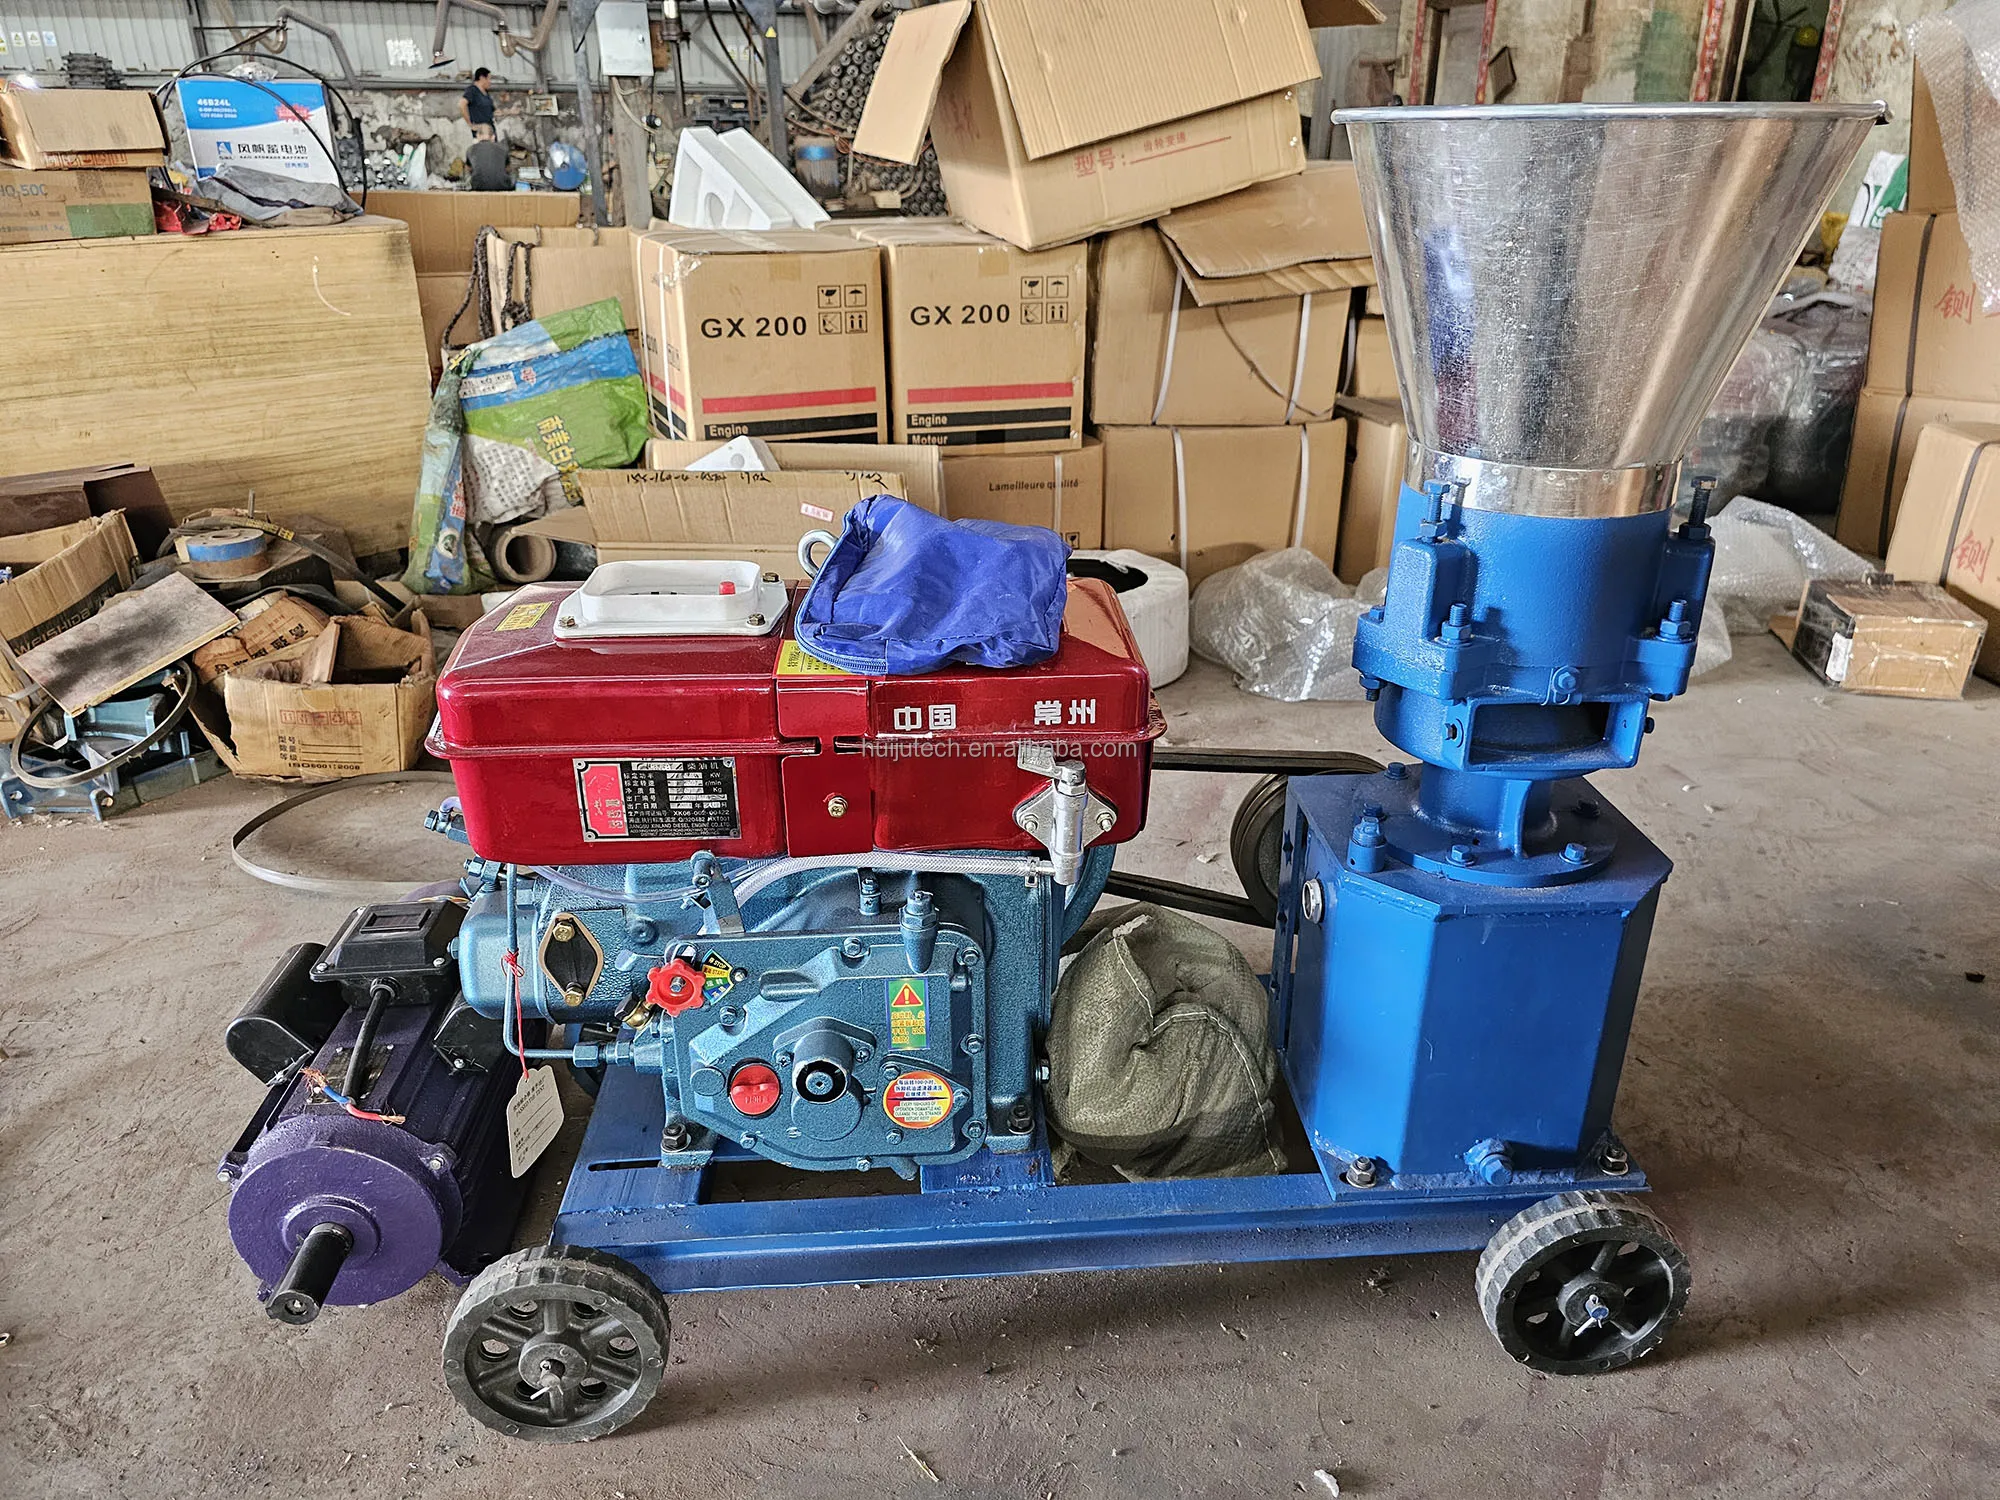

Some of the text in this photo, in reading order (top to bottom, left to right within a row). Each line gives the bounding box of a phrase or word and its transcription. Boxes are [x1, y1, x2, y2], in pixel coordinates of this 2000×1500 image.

[197, 98, 231, 106] 46B24L
[910, 304, 1010, 326] GX 200
[700, 316, 807, 338] GX 200
[911, 414, 948, 428] Engine
[709, 424, 749, 438] Engine
[911, 434, 949, 445] Moteur
[988, 481, 1045, 492] Lameilleure
[893, 699, 1096, 731] 中国 常州
